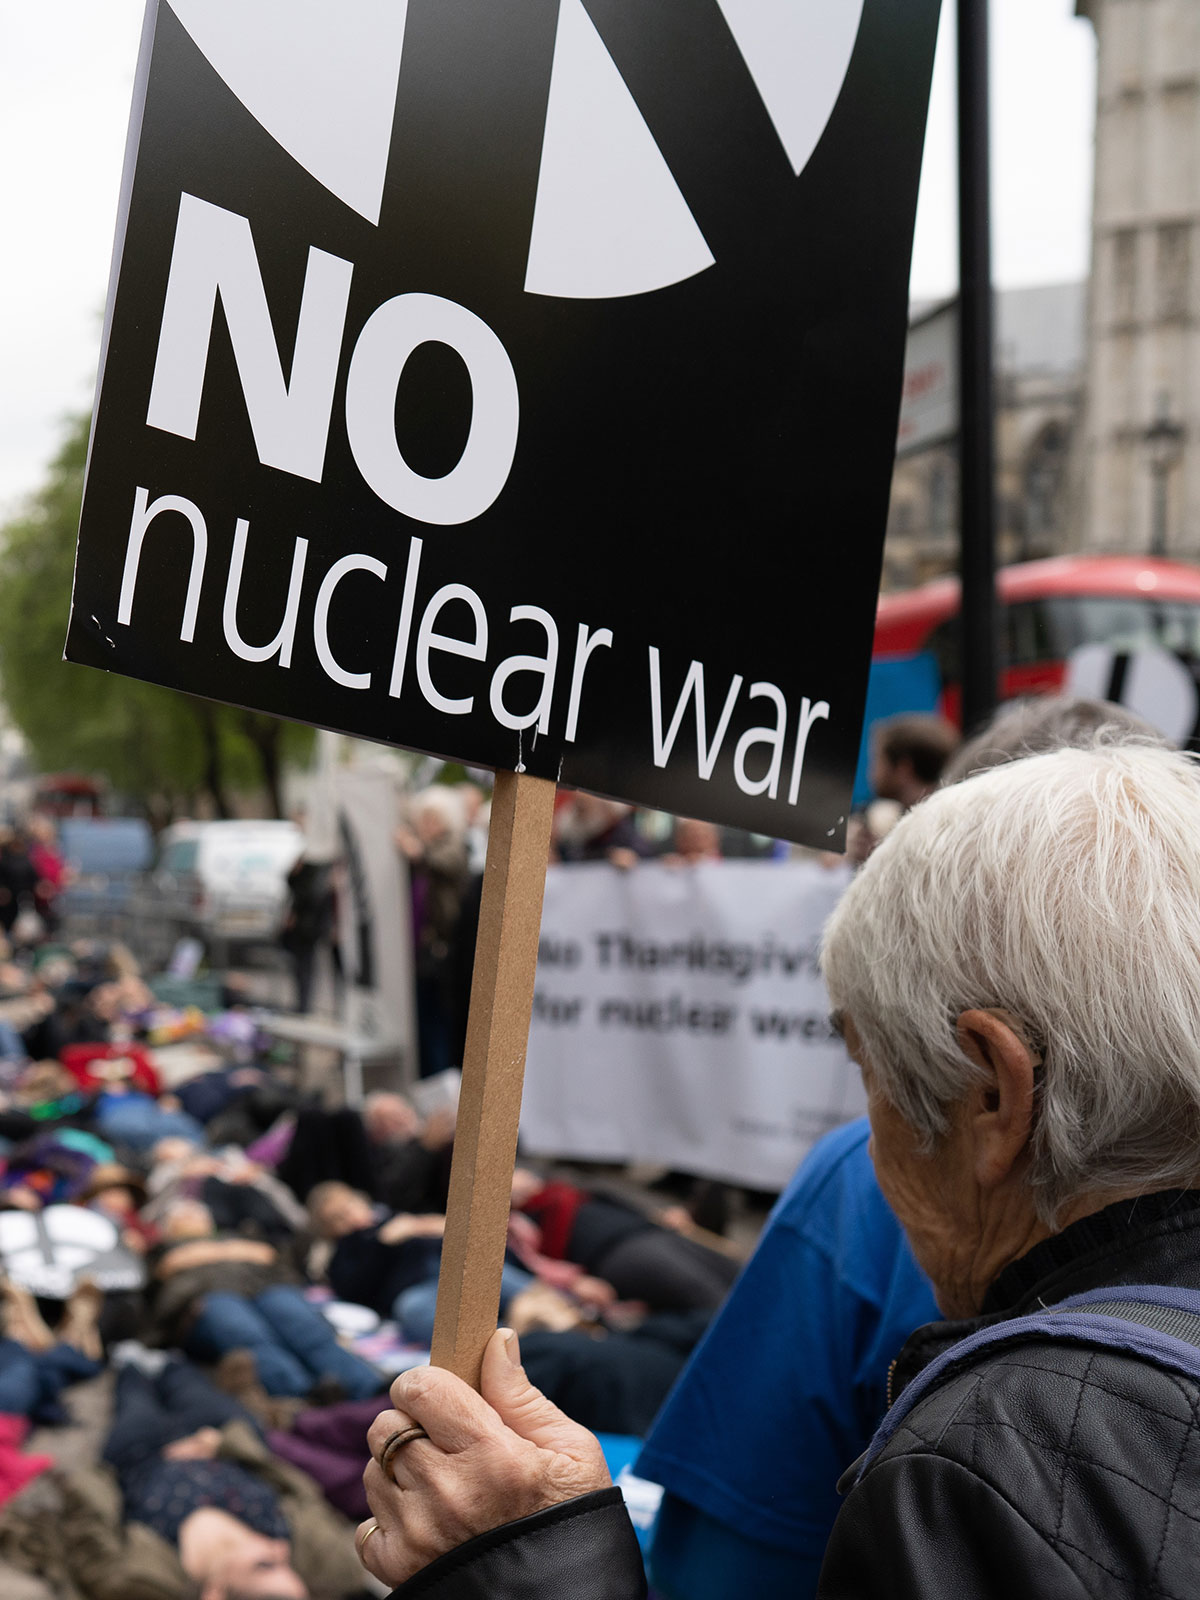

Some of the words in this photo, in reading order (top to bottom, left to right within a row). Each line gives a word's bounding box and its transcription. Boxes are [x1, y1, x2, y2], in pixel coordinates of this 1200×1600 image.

[146, 191, 520, 526] NO
[117, 486, 614, 743] nuclear
[648, 645, 830, 806] war
